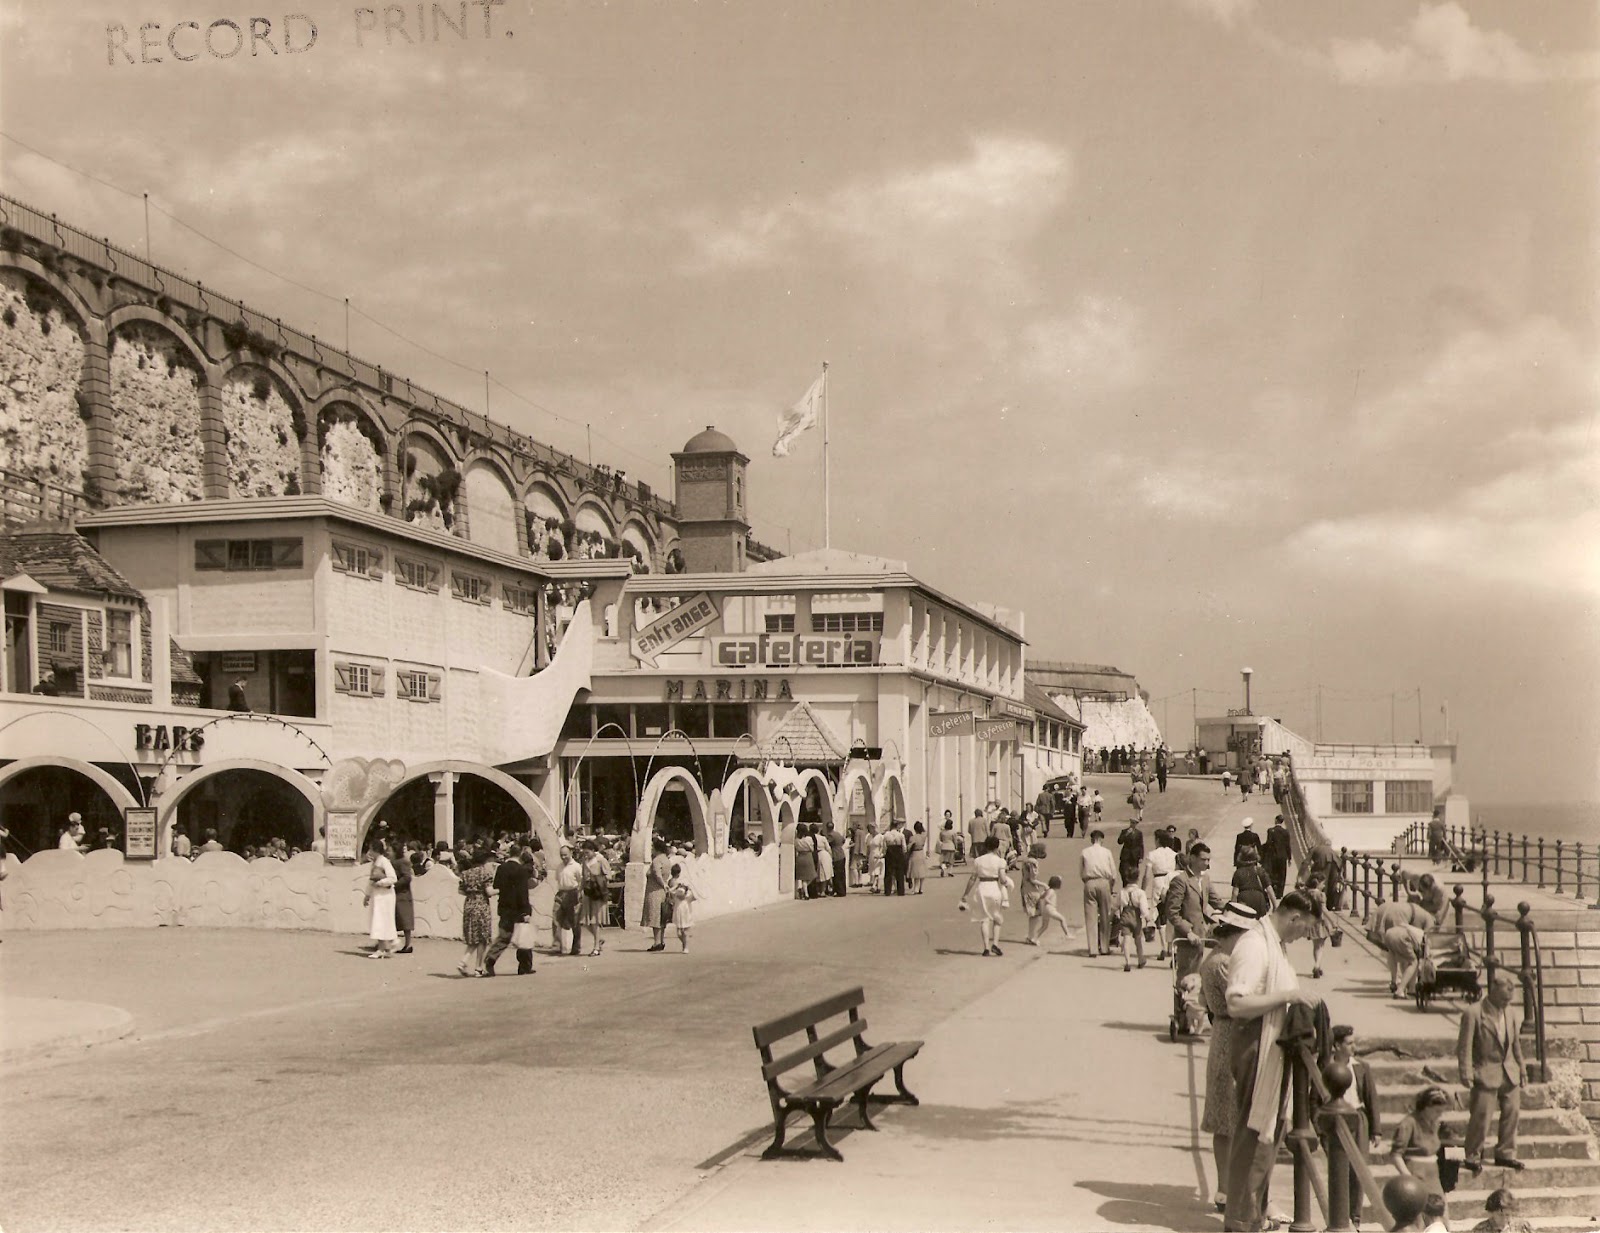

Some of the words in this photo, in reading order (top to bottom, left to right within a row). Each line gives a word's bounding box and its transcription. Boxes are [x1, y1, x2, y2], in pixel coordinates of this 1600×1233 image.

[637, 600, 713, 655] entrance
[718, 633, 873, 664] cafeteria
[665, 679, 794, 700] MARINA
[930, 711, 971, 736] Cafeteria
[977, 720, 1014, 741] Cafeteria
[135, 723, 205, 751] BARS
